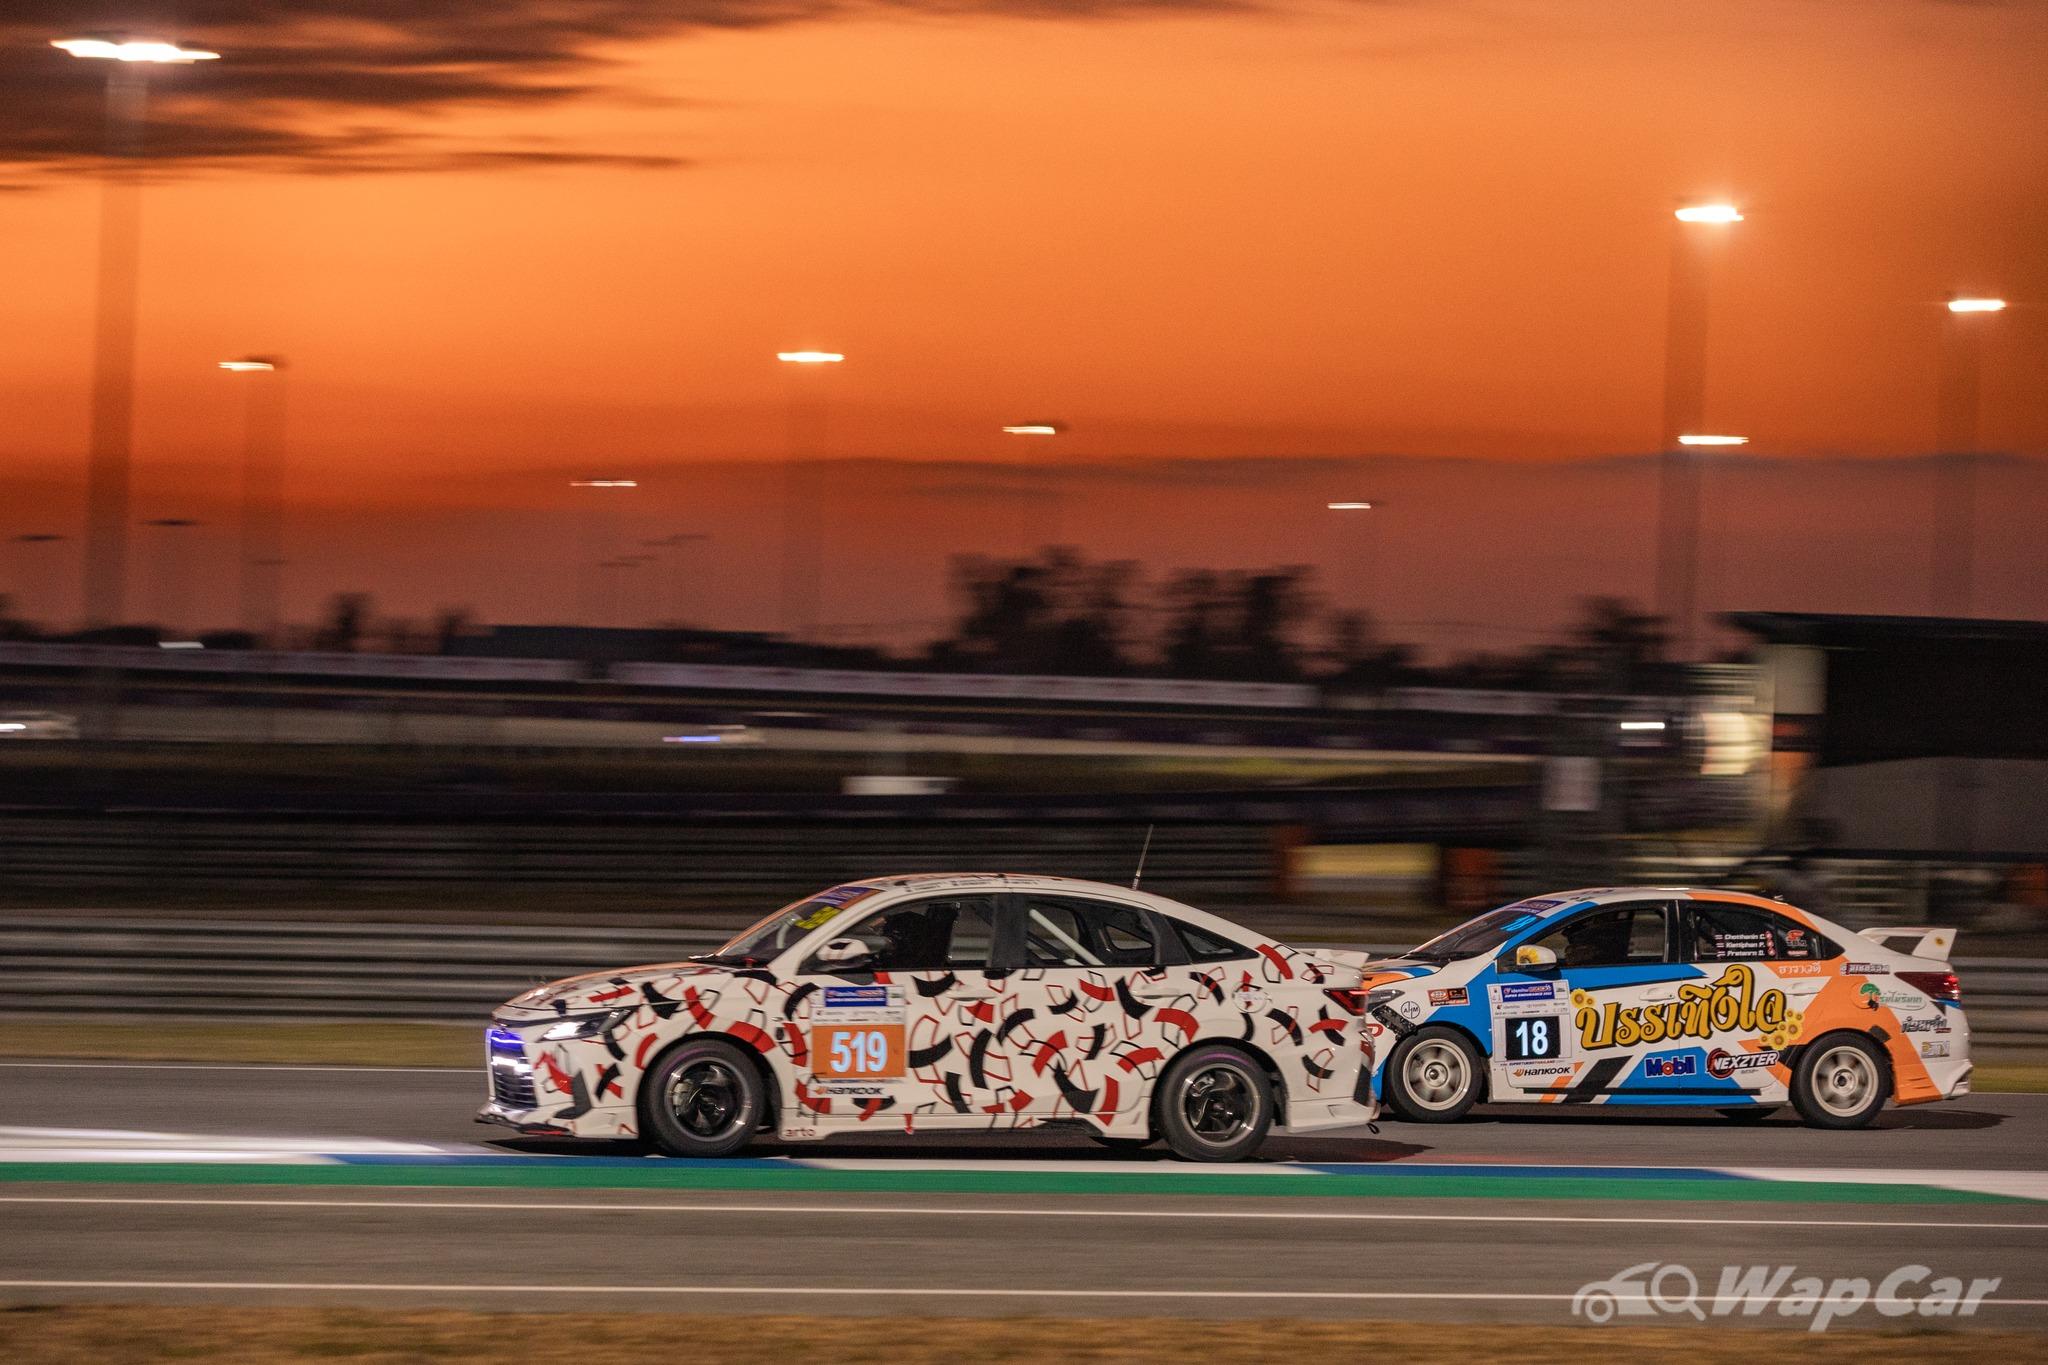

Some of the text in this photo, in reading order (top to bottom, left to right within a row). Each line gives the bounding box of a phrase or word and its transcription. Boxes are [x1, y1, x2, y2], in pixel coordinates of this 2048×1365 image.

[830, 1031, 888, 1072] 519
[1515, 1020, 1549, 1056] 18
[1645, 1056, 1696, 1077] Mobil
[1714, 1052, 1777, 1070] NEXZTER
